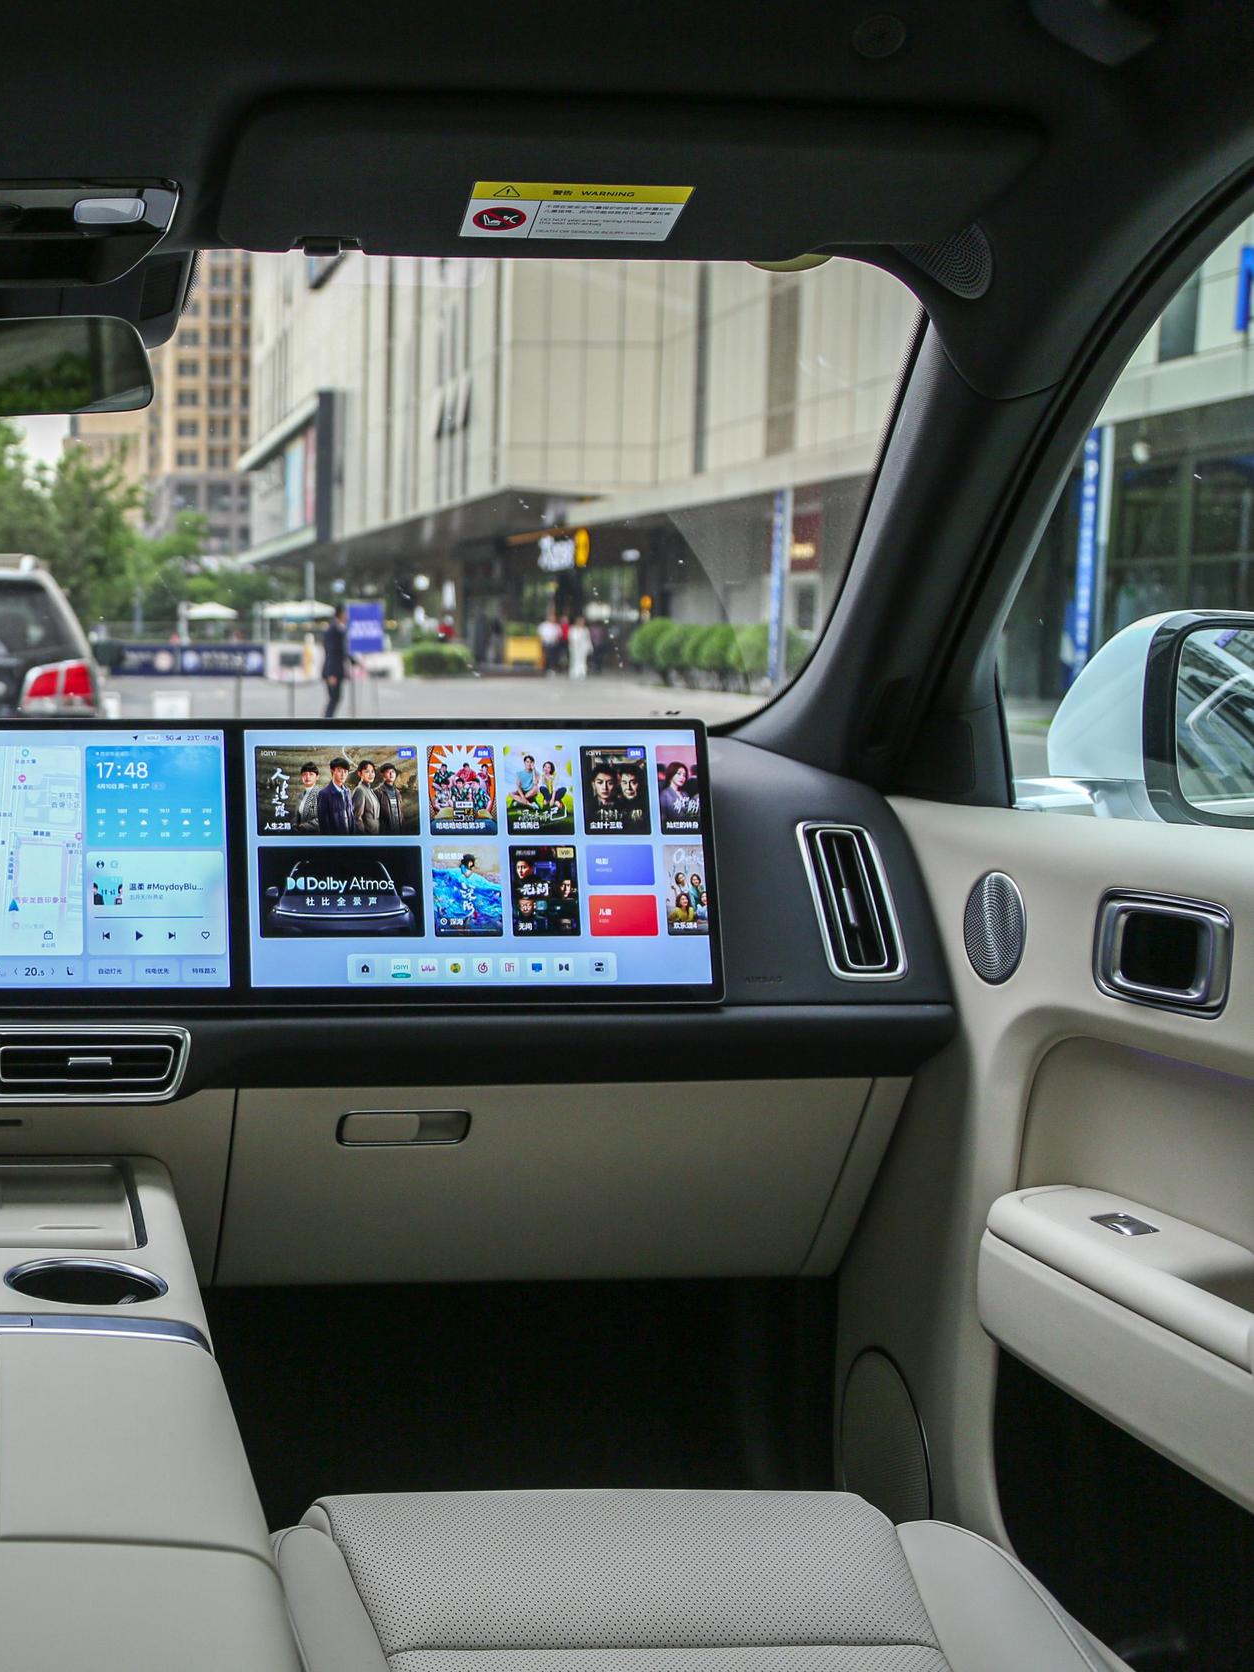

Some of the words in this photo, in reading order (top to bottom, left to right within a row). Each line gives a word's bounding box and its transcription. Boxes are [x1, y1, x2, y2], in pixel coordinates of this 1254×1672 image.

[96, 761, 148, 779] 17:48
[264, 822, 292, 830] 人生之路
[436, 822, 486, 830] 哈哈哈哈哈第3季
[513, 822, 540, 830] 爱情而已
[589, 821, 624, 829] 尘封十三载
[666, 821, 699, 829] 灿烂的转身
[129, 882, 144, 891] 温柔
[306, 876, 348, 893] Dolby
[349, 876, 394, 891] Atmos
[305, 896, 378, 906] 杜比全景声
[598, 908, 612, 916] 儿童
[449, 918, 464, 926] 深海
[673, 921, 698, 929] 欢乐颂4
[517, 922, 533, 931] 无间
[24, 966, 45, 977] 20.5
[192, 966, 217, 974] 特殊路况
